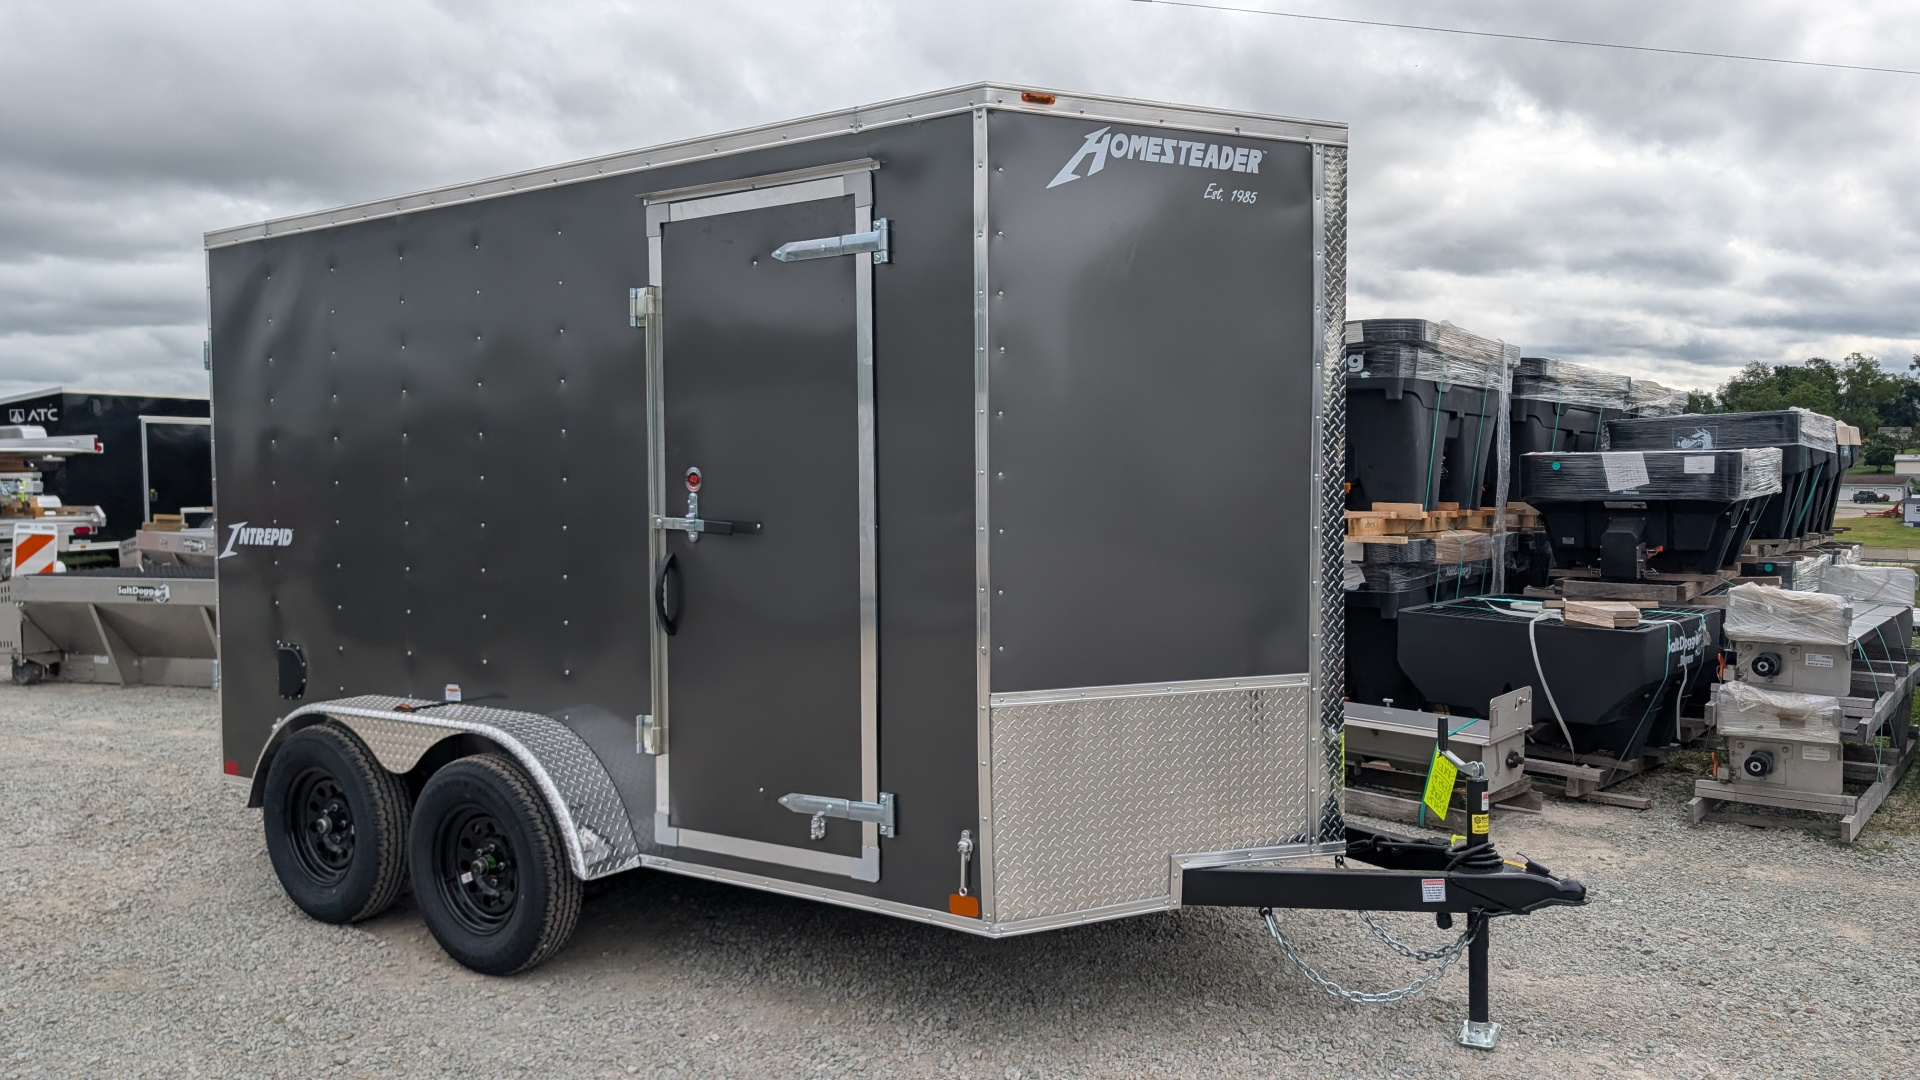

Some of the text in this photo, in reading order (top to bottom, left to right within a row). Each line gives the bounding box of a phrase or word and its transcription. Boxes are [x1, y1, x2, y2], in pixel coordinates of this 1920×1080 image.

[1046, 126, 1263, 189] HOMESTEADER
[1203, 183, 1258, 204] Est. 1985
[27, 408, 59, 421] ATC
[219, 521, 293, 559] INTREPID
[118, 586, 154, 597] SaltDogg
